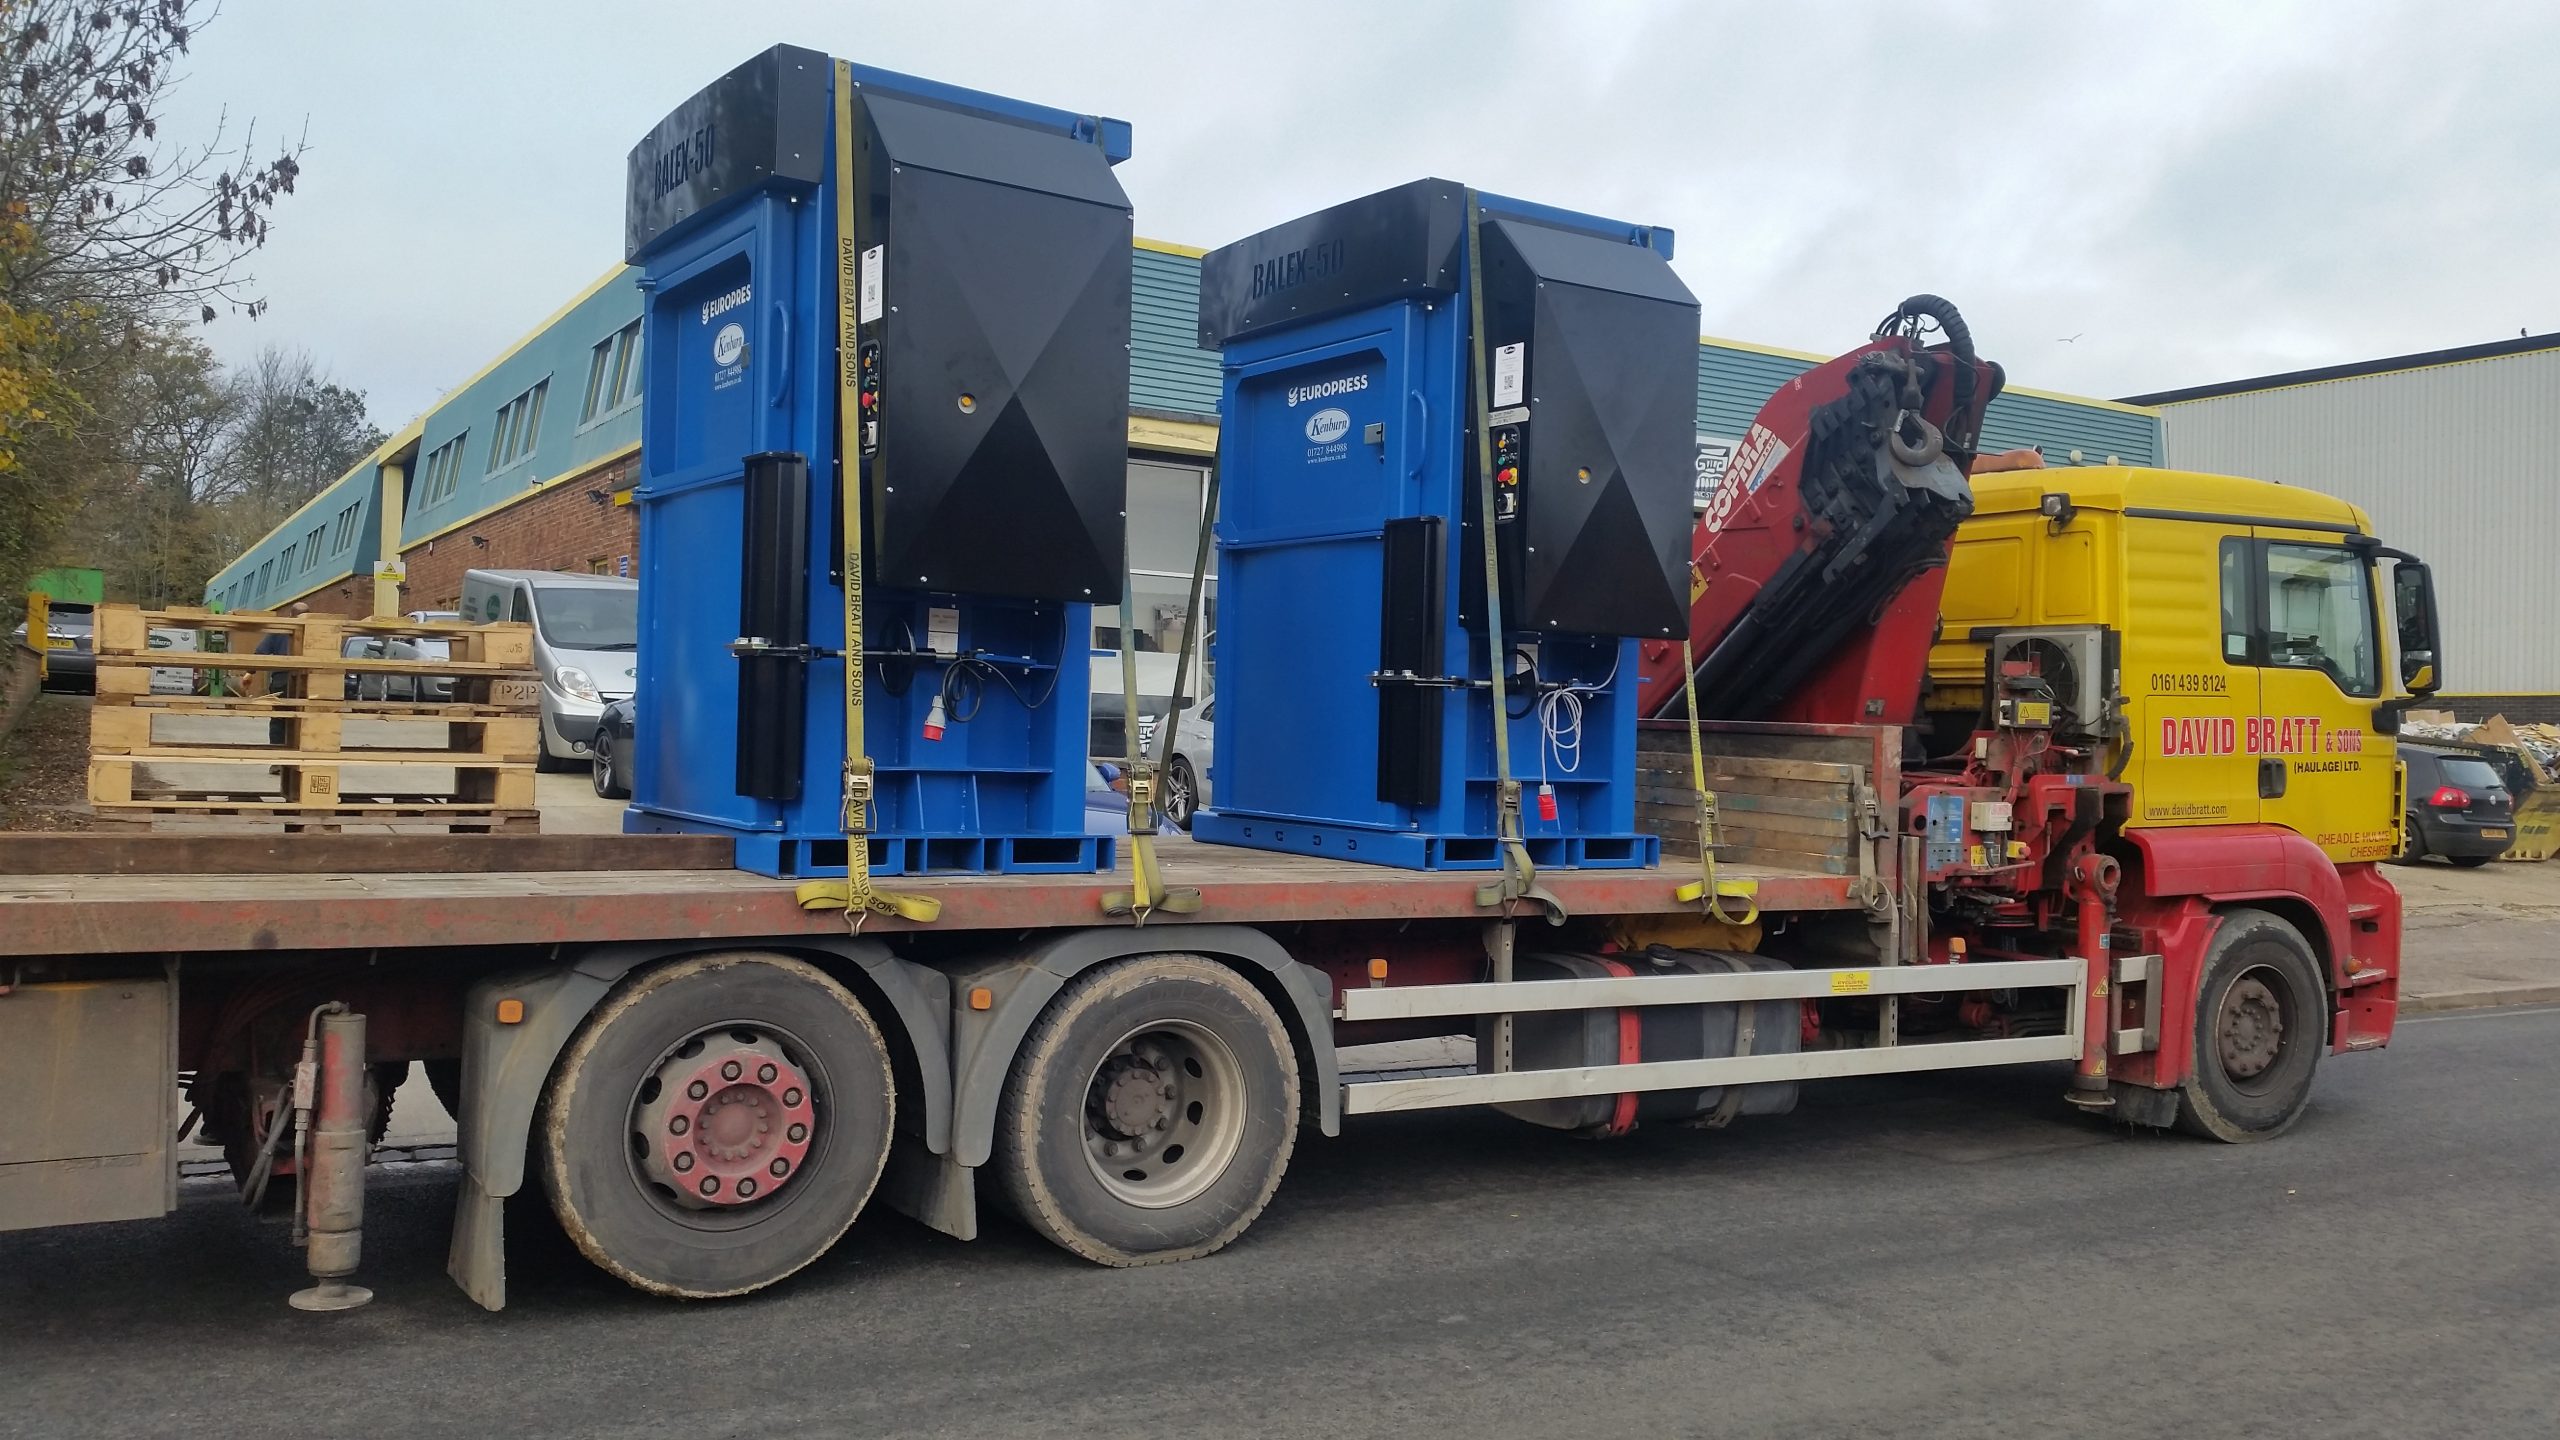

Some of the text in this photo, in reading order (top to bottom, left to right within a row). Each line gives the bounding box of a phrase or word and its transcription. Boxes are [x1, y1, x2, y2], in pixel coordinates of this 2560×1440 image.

[654, 123, 715, 201] BALEX-50
[1252, 239, 1344, 300] BALEX-50
[709, 284, 751, 318] EUROPRES
[842, 237, 857, 388] DAVID BRATT AND SONS
[1299, 374, 1369, 402] EUROPRESS
[1311, 418, 1348, 437] Kenburn
[1705, 423, 1772, 533] COPMA
[849, 552, 863, 706] DAVID BRATT AND SONS
[2151, 673, 2226, 692] 0161 439 8124
[2161, 716, 2363, 757] DAVID BRATT & SONS
[2293, 760, 2362, 775] (HAULAGE) LTD.
[853, 790, 864, 829] DAVID
[2149, 803, 2227, 817] www.davidbratt.com
[2317, 832, 2360, 846] CHEADLE
[2350, 845, 2389, 858] CHESHIRE
[858, 871, 870, 896] AND
